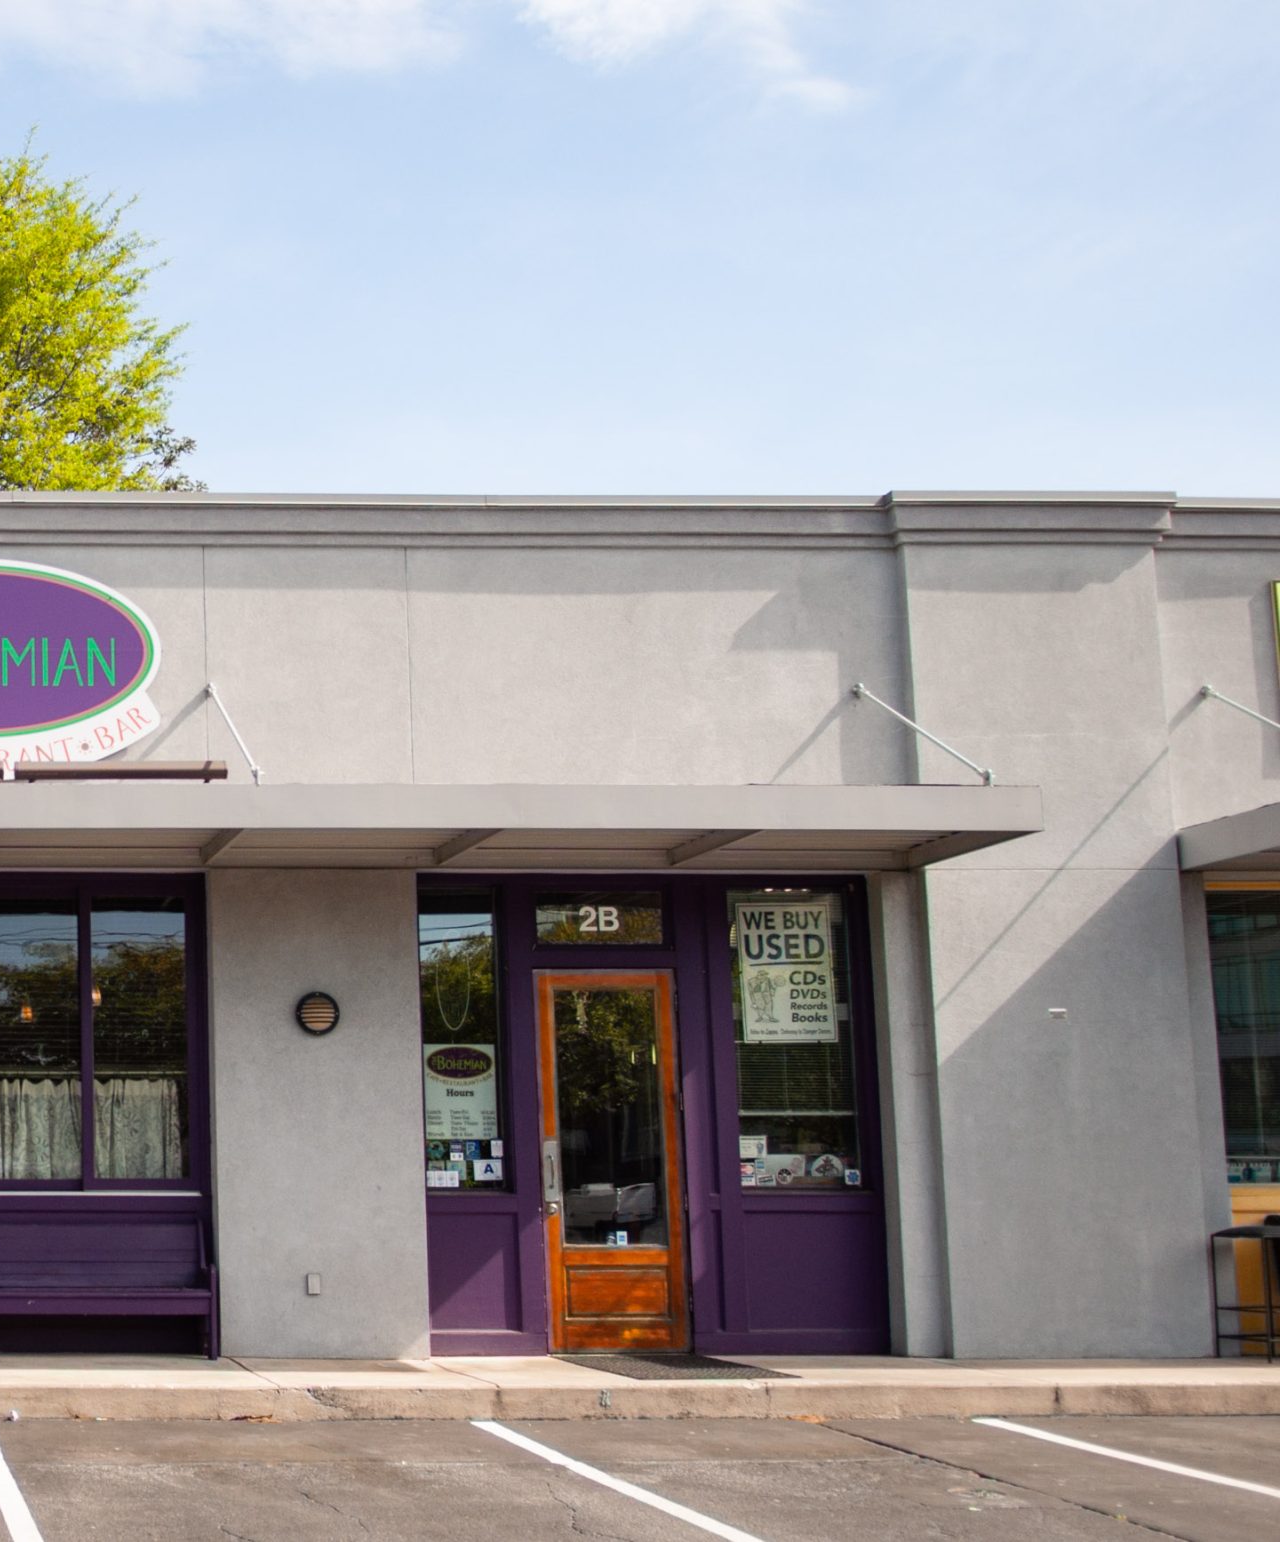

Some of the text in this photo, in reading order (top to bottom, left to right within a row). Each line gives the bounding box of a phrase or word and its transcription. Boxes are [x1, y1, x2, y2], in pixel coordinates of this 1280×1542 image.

[93, 707, 152, 750] BAR
[578, 906, 619, 932] 2B
[742, 911, 823, 930] WE BUY
[743, 934, 825, 960] USED
[788, 970, 826, 986] CDs
[790, 988, 827, 1000] DVDs
[790, 1001, 828, 1010] Records
[791, 1012, 828, 1023] Books
[446, 1088, 474, 1097] Hours
[483, 1163, 494, 1174] A
